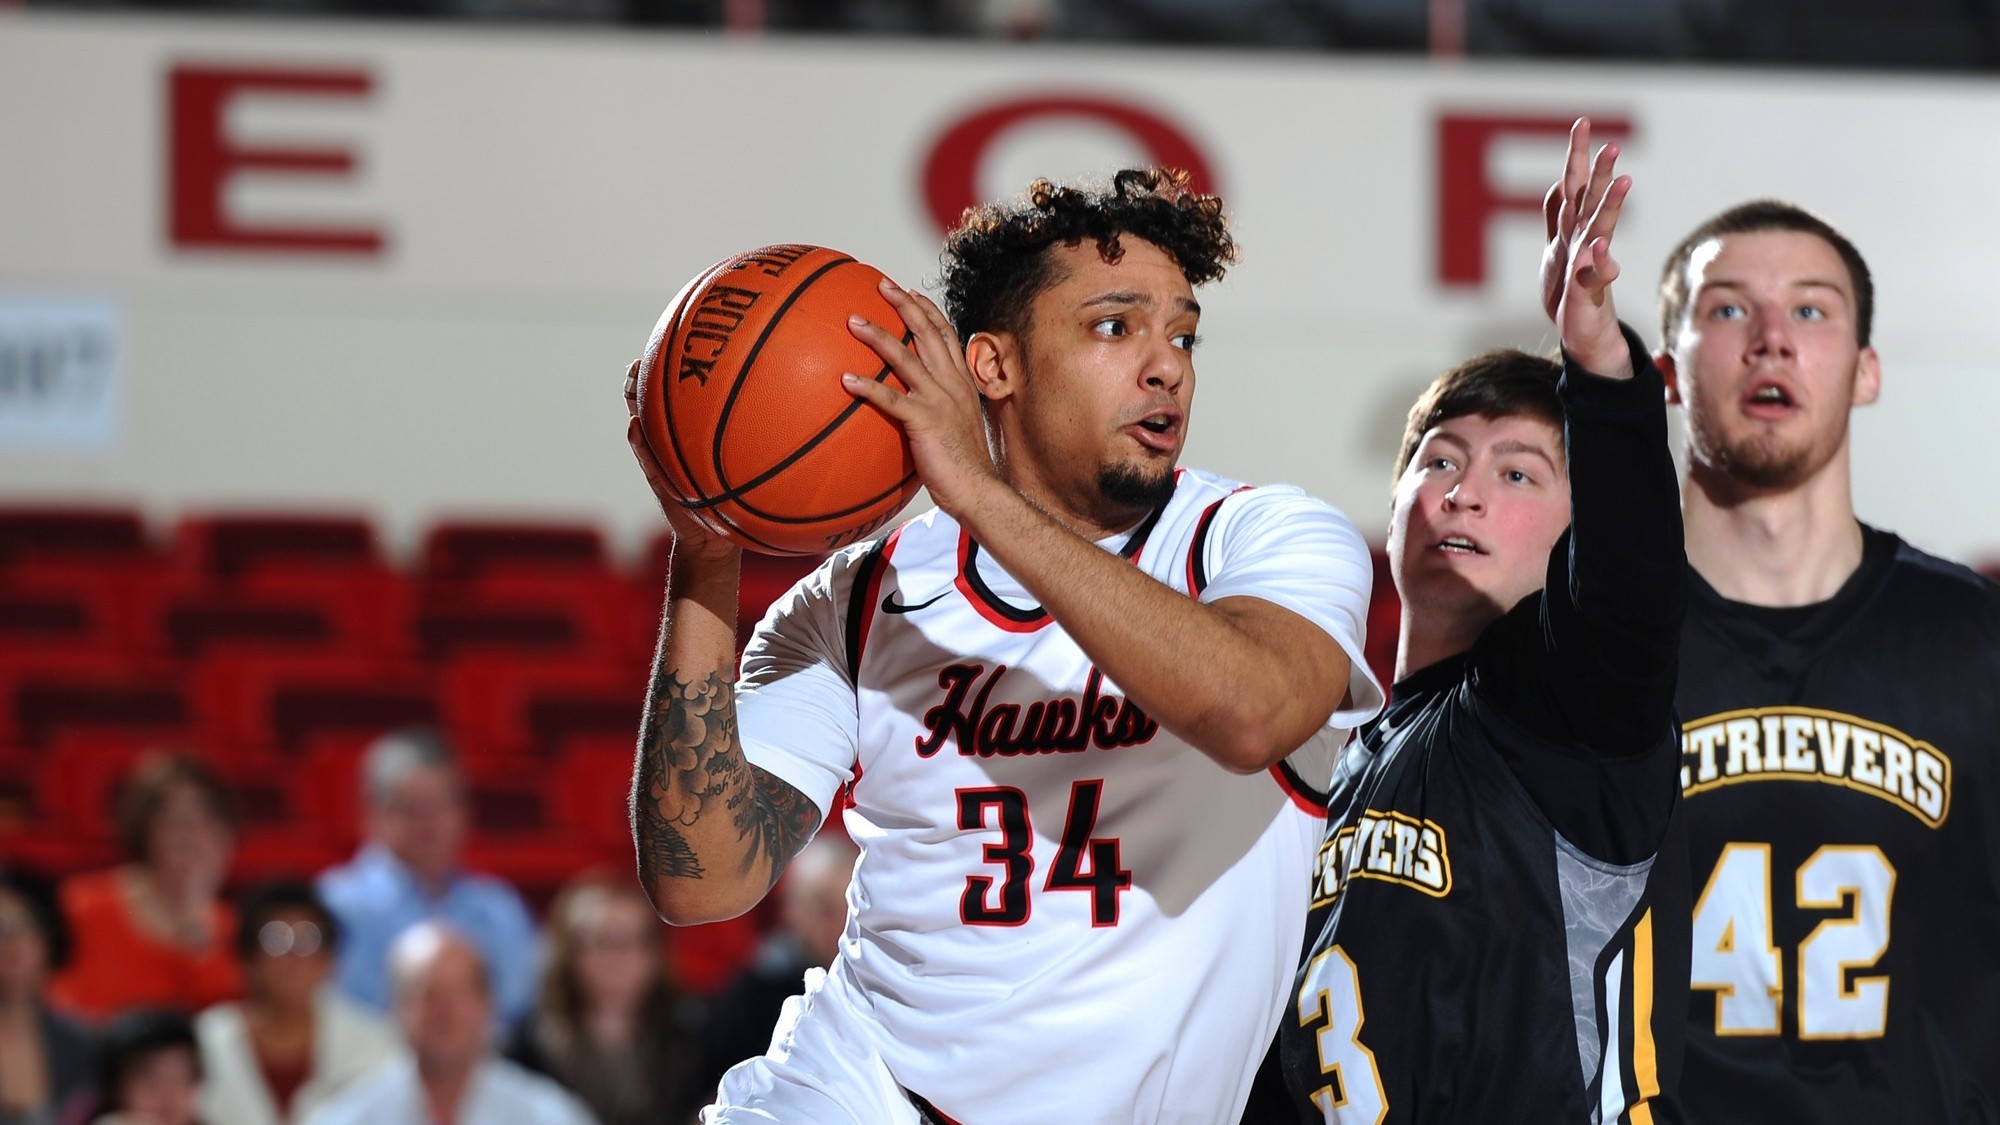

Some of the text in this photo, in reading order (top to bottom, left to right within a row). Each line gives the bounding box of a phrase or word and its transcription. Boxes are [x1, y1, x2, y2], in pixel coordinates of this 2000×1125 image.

[679, 283, 763, 387] ROCK
[915, 663, 1160, 758] Hawks
[954, 778, 1132, 928] 34
[1690, 842, 1897, 1041] 42
[1298, 943, 1389, 1125] 3
